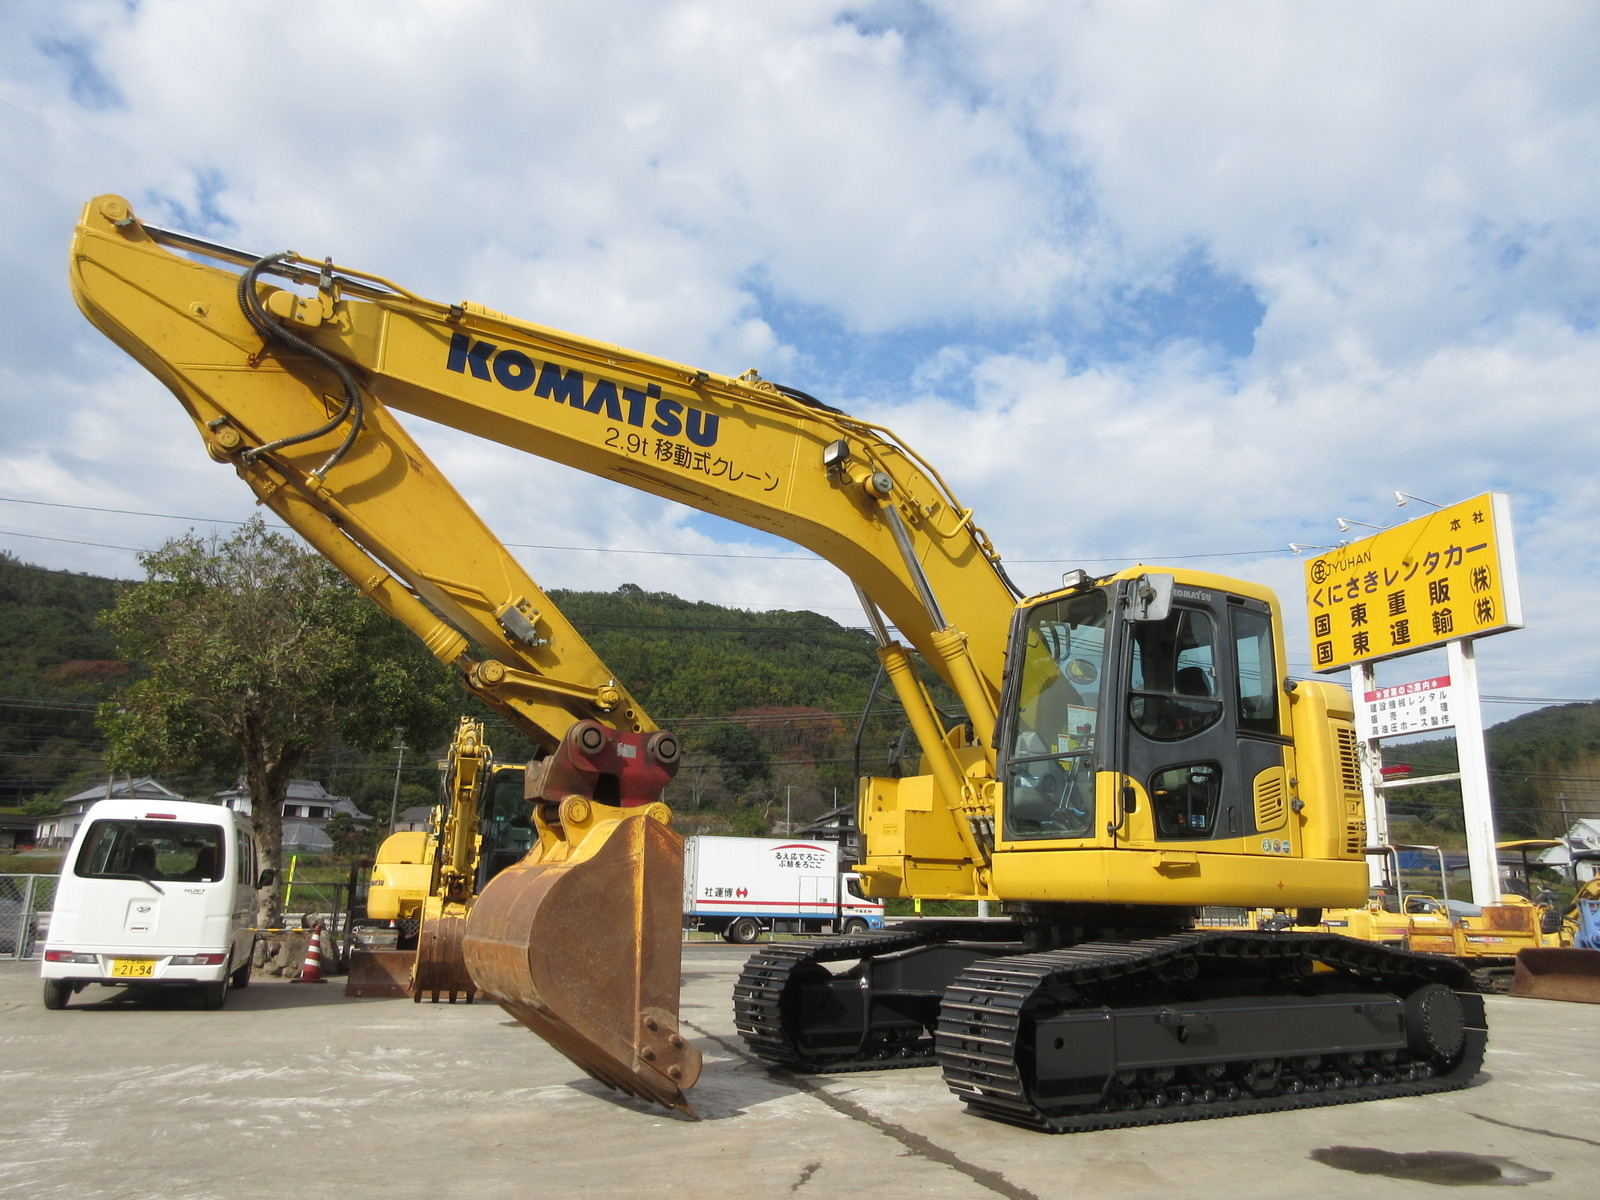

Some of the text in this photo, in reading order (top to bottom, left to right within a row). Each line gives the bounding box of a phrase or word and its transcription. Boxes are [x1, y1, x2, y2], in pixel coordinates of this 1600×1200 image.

[446, 332, 719, 447] KOMATSU
[604, 427, 779, 491] 2.9t 移動式クレーン
[1450, 510, 1484, 531] 本社
[1313, 543, 1487, 608] くにさきレンタカー
[1325, 551, 1371, 576] JYUHAN
[121, 965, 152, 975] 21-94
